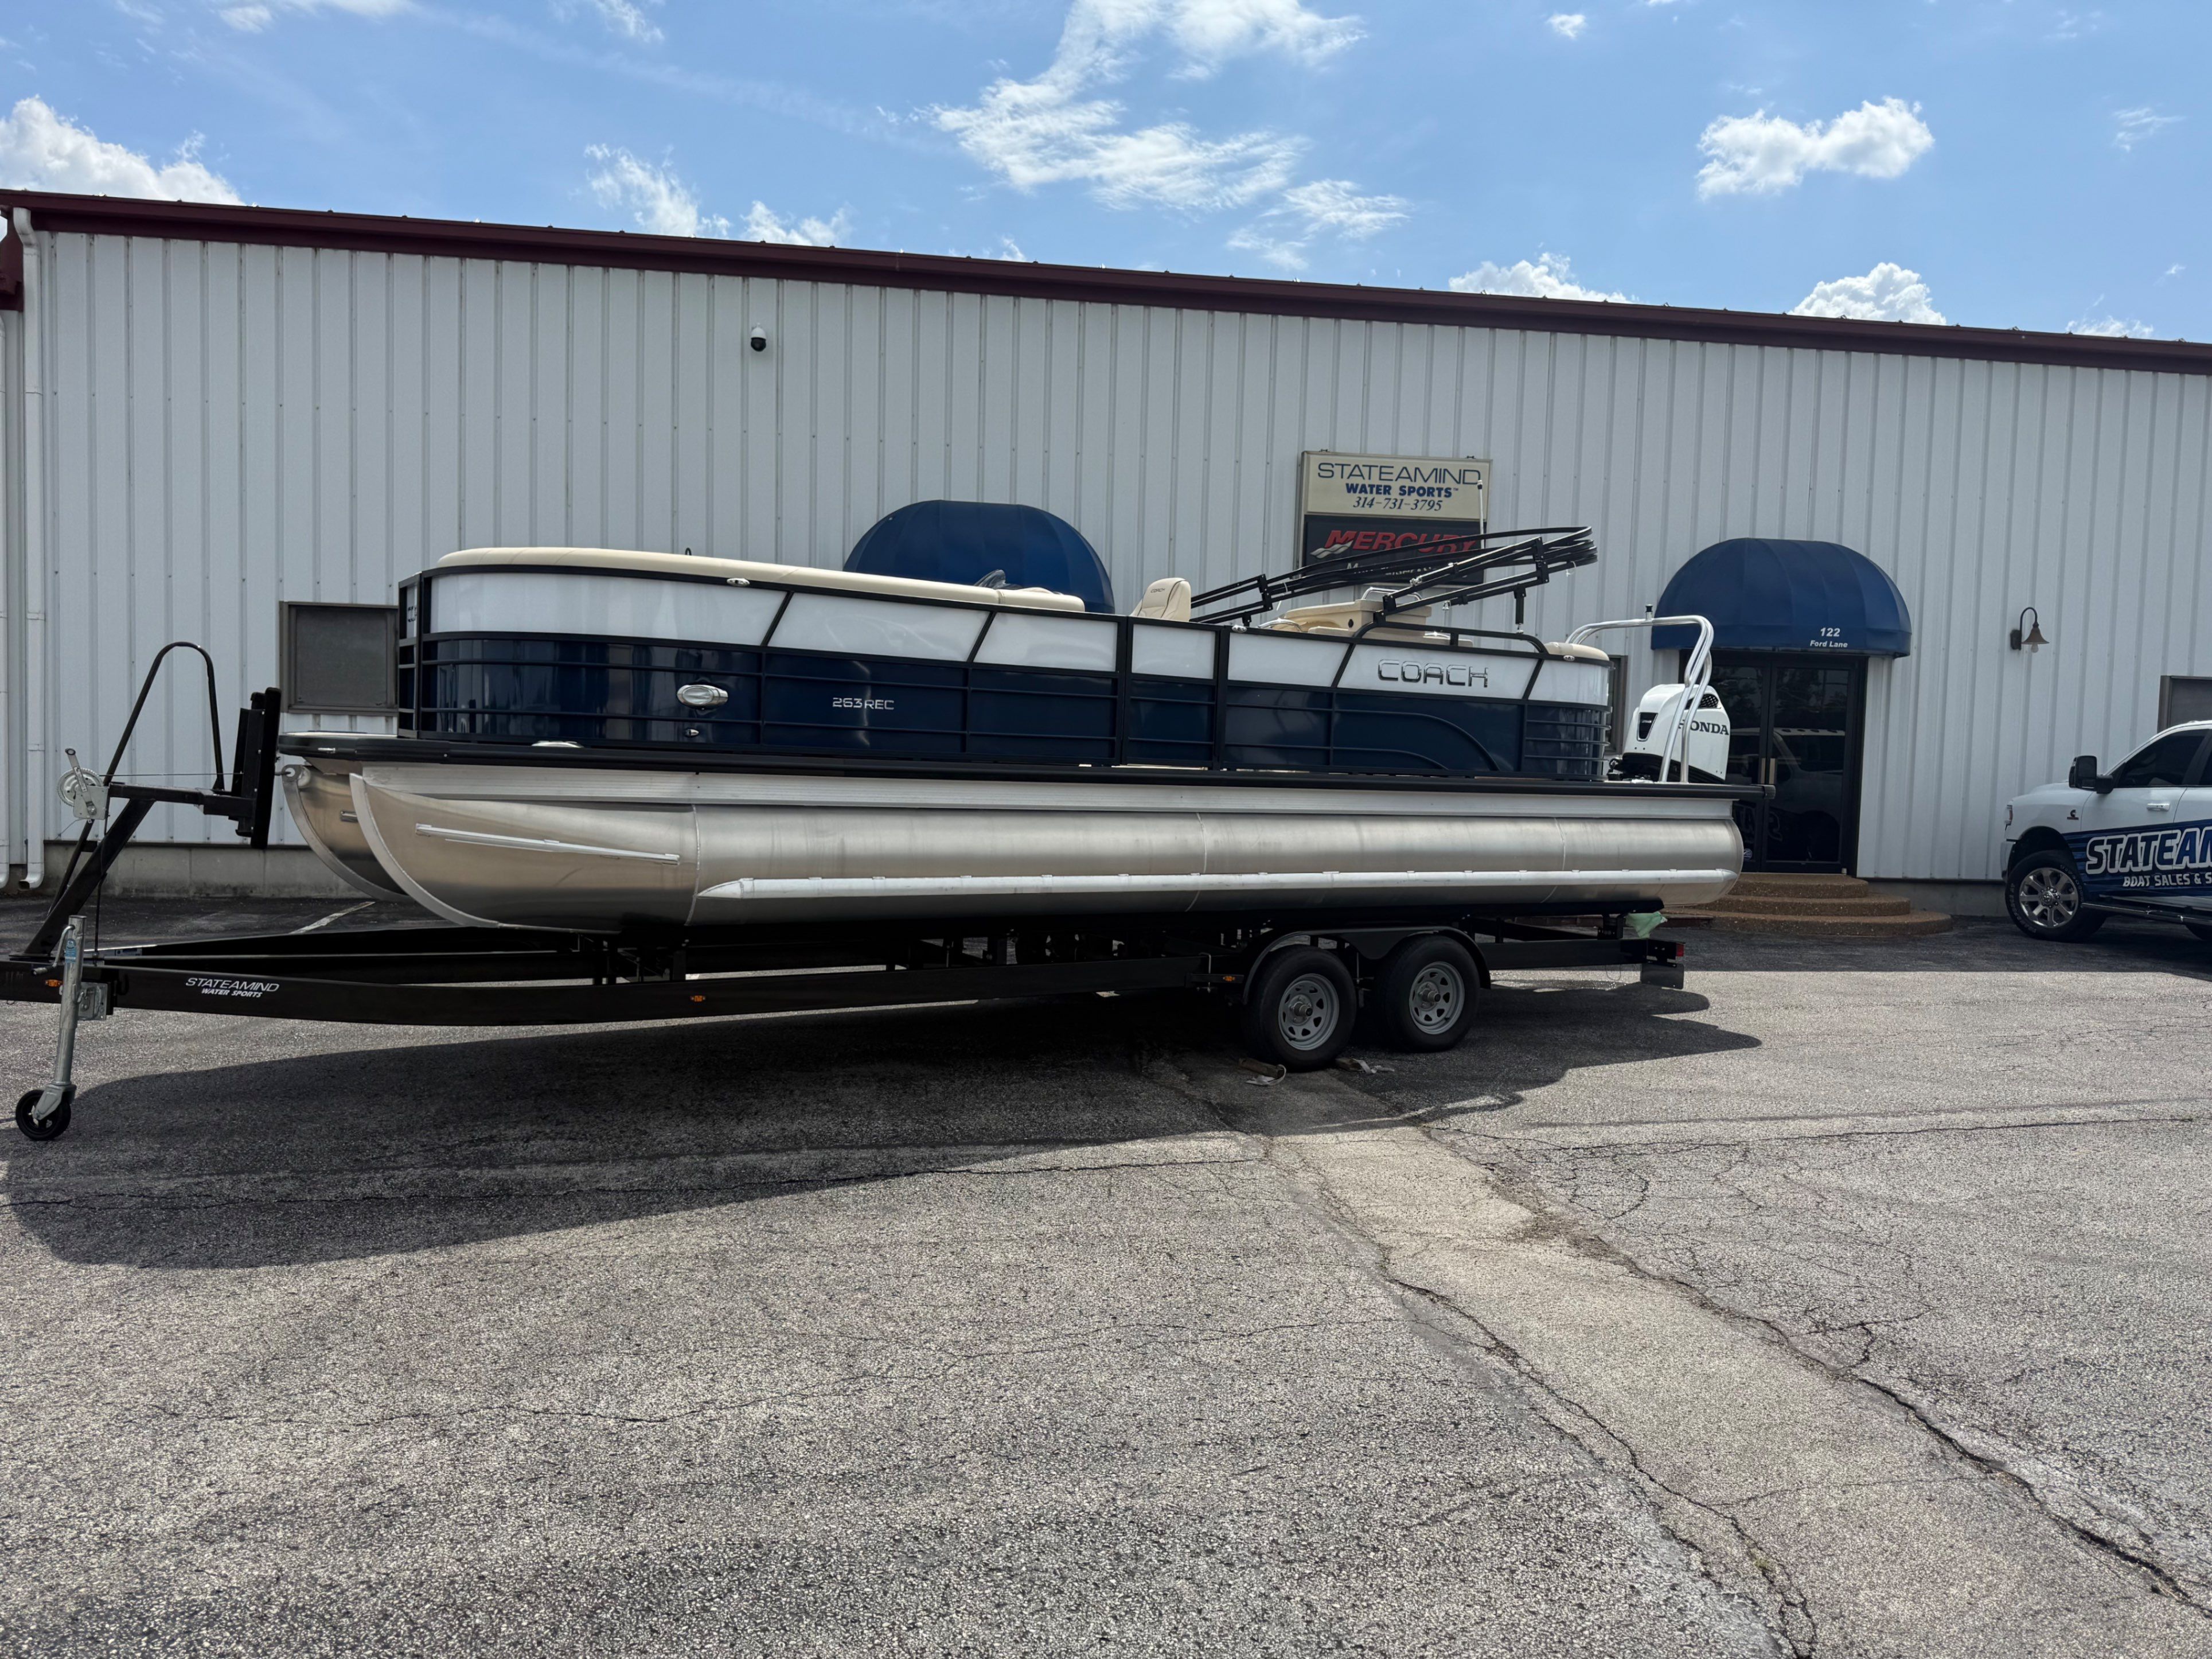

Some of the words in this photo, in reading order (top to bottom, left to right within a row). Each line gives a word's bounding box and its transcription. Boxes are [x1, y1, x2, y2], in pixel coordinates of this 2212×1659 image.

[1318, 462, 1481, 485] STATEAMIND
[1345, 483, 1392, 496] WATER
[1399, 486, 1452, 498] SPORTS
[1353, 497, 1443, 511] 314-731-3795
[1820, 627, 1840, 637] 122
[1378, 659, 1489, 688] COACH
[2123, 875, 2151, 887] BOAT
[2155, 874, 2191, 886] SALES
[2194, 873, 2202, 885] &
[185, 978, 280, 992] STATEAMIND
[231, 990, 263, 998] SPORTS
